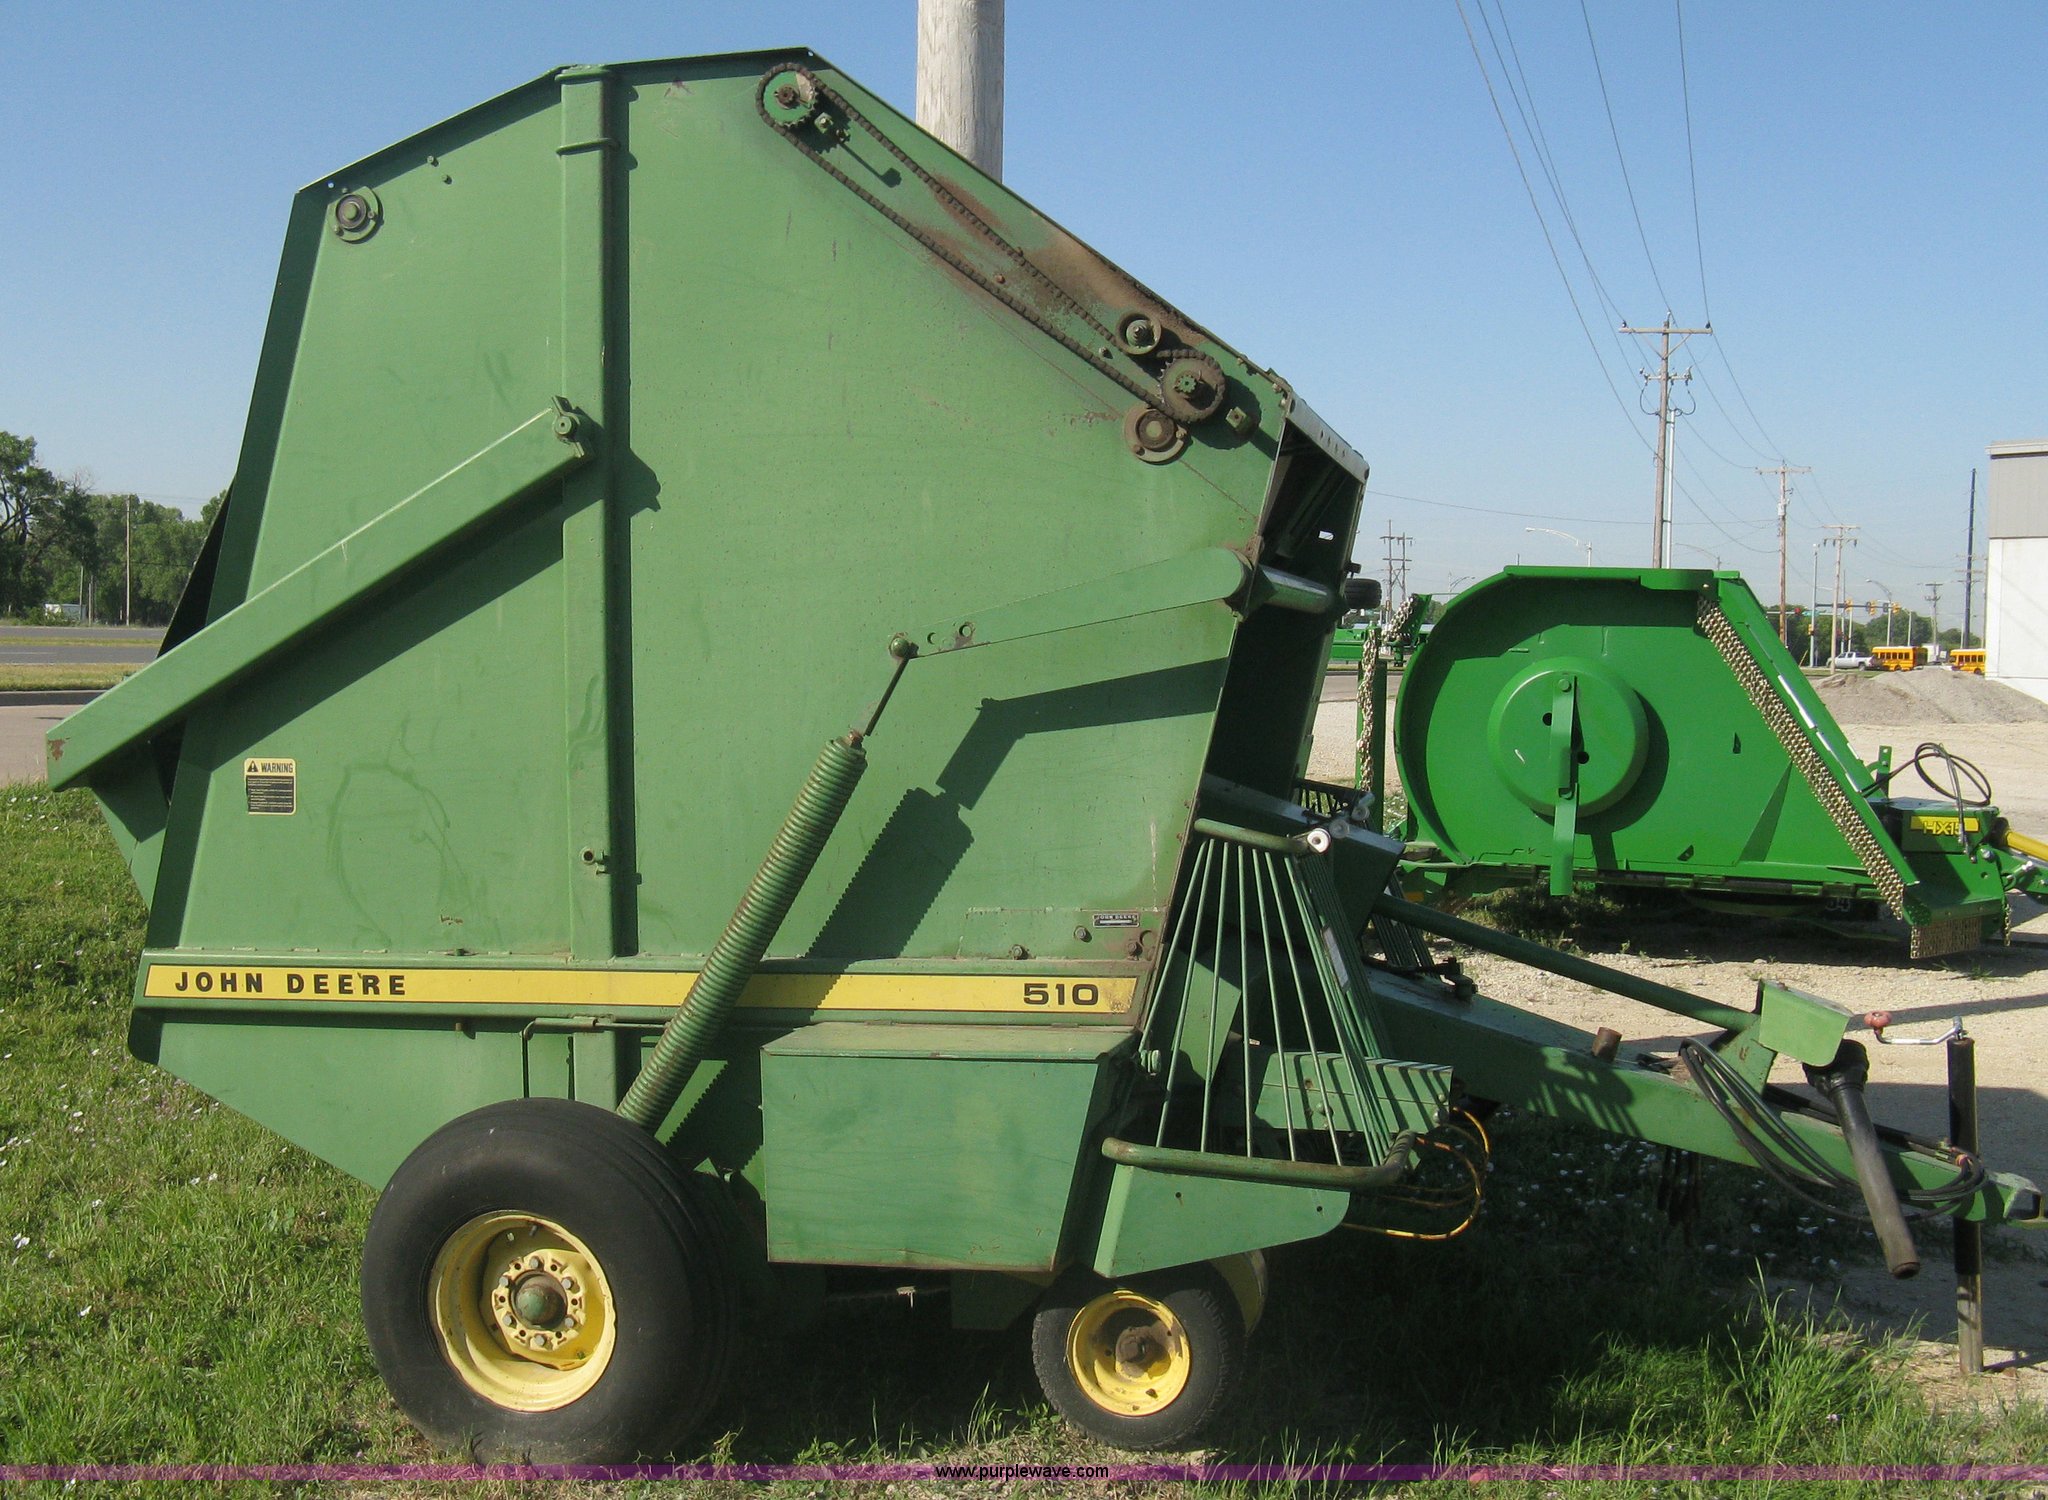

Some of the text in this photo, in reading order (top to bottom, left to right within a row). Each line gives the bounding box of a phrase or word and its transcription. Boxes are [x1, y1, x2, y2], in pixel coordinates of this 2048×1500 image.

[260, 762, 293, 773] WARNING
[175, 972, 405, 996] JOHN DEERE
[1023, 983, 1099, 1006] 510
